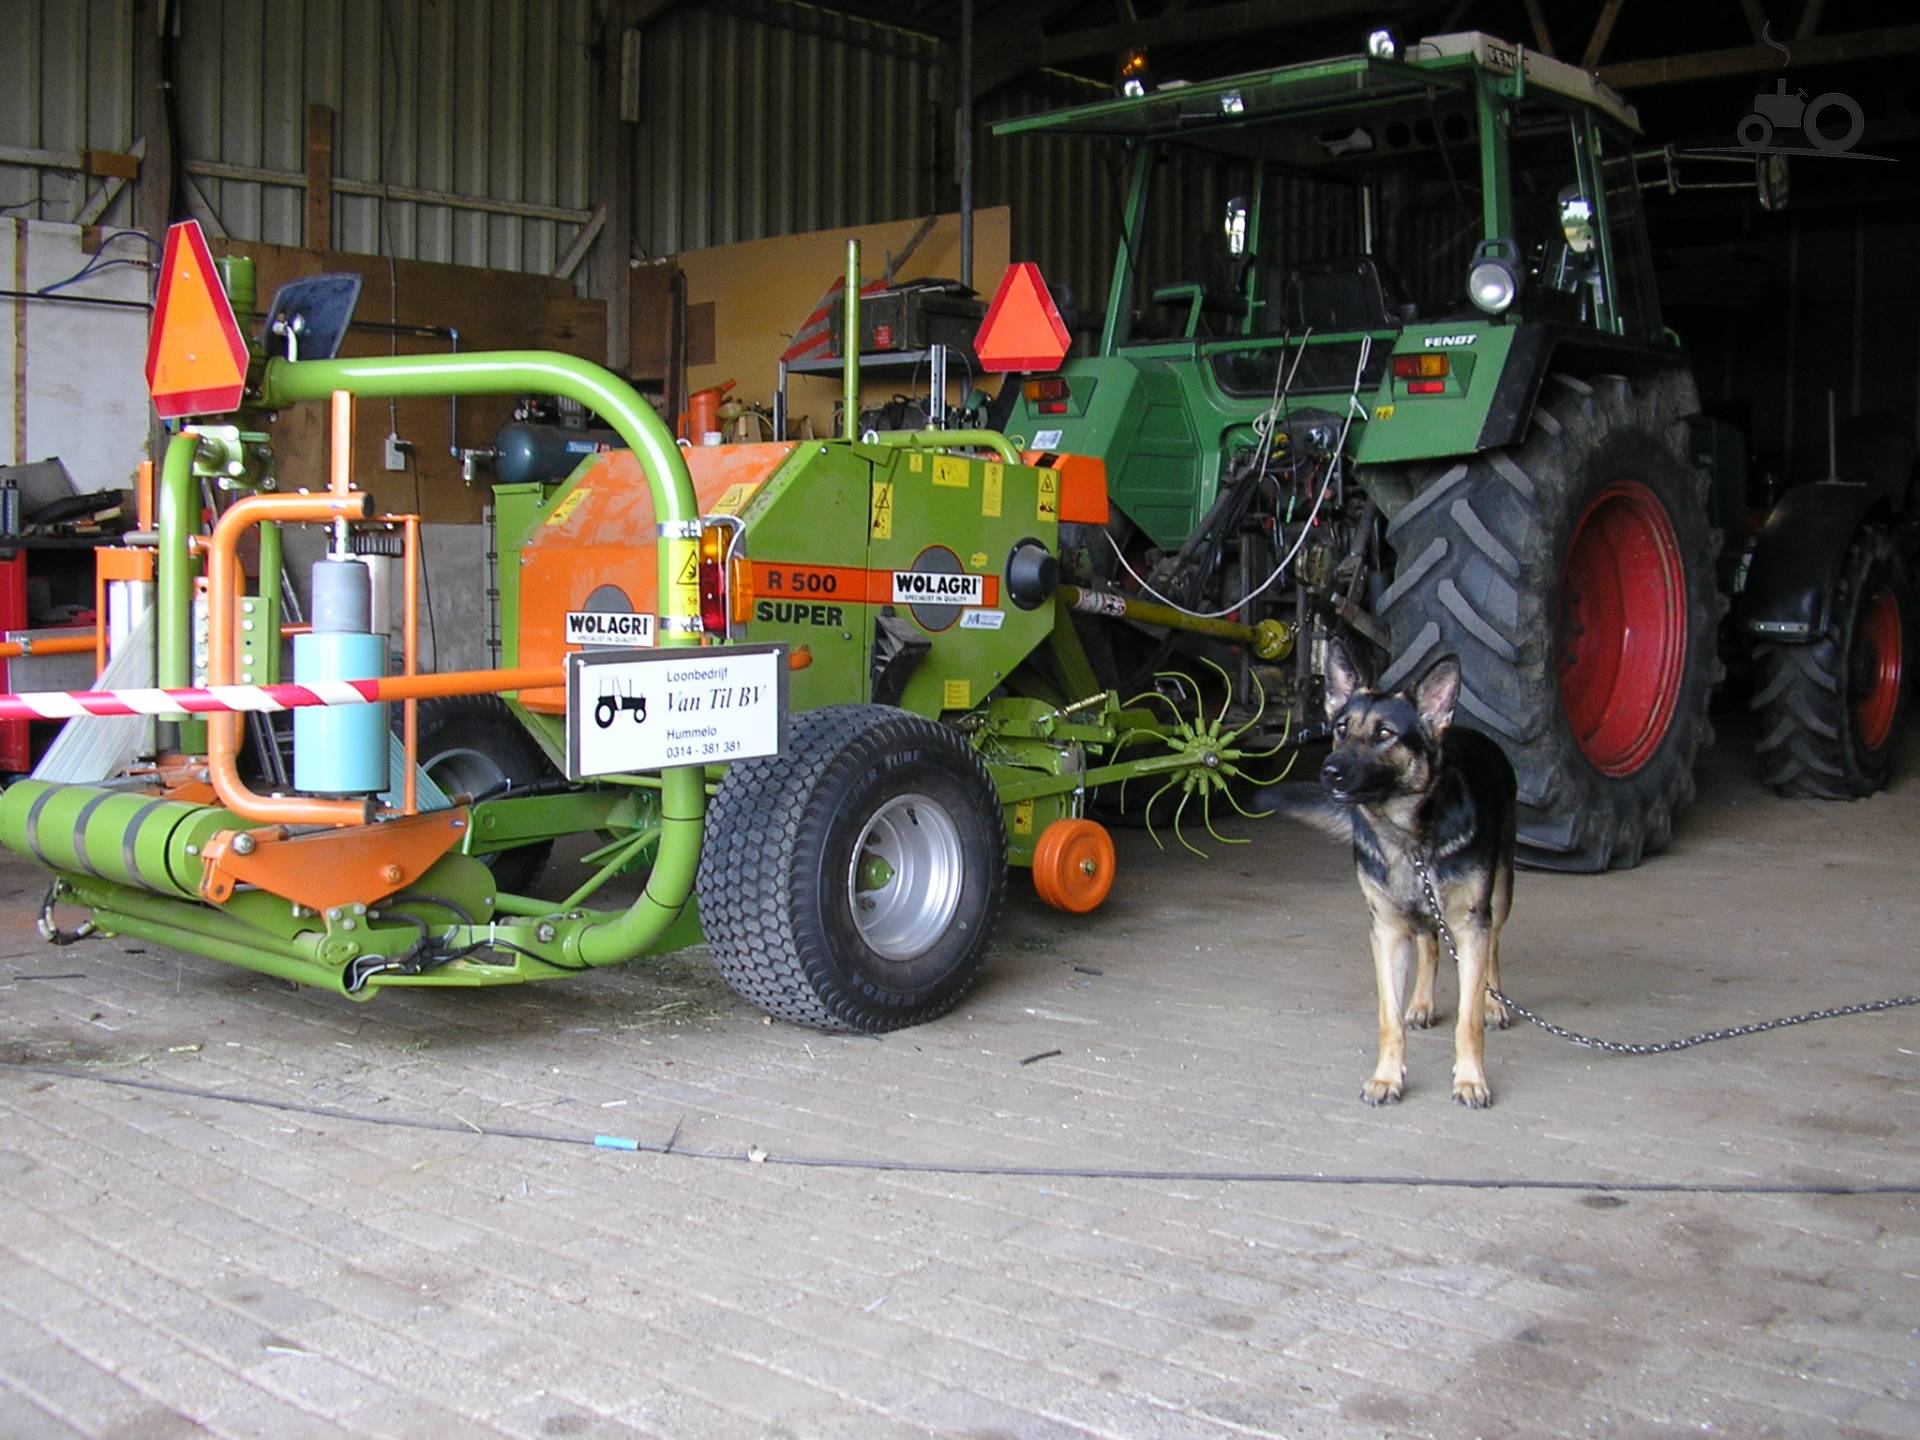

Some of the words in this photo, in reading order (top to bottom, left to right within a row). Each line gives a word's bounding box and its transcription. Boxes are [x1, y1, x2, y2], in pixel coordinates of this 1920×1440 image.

[1424, 334, 1478, 348] FENDT
[767, 571, 783, 592] R
[791, 573, 837, 594] 500
[896, 574, 977, 595] WOLAGRI
[757, 601, 842, 626] SUPER
[569, 615, 648, 635] WOLAGRI
[667, 667, 728, 682] Loonbedrijf
[668, 691, 701, 712] Van
[710, 687, 732, 709] Til
[738, 684, 767, 707] BV
[667, 725, 717, 740] Hummelo
[666, 746, 692, 758] 0314
[702, 743, 720, 755] 381
[723, 740, 741, 753] 381
